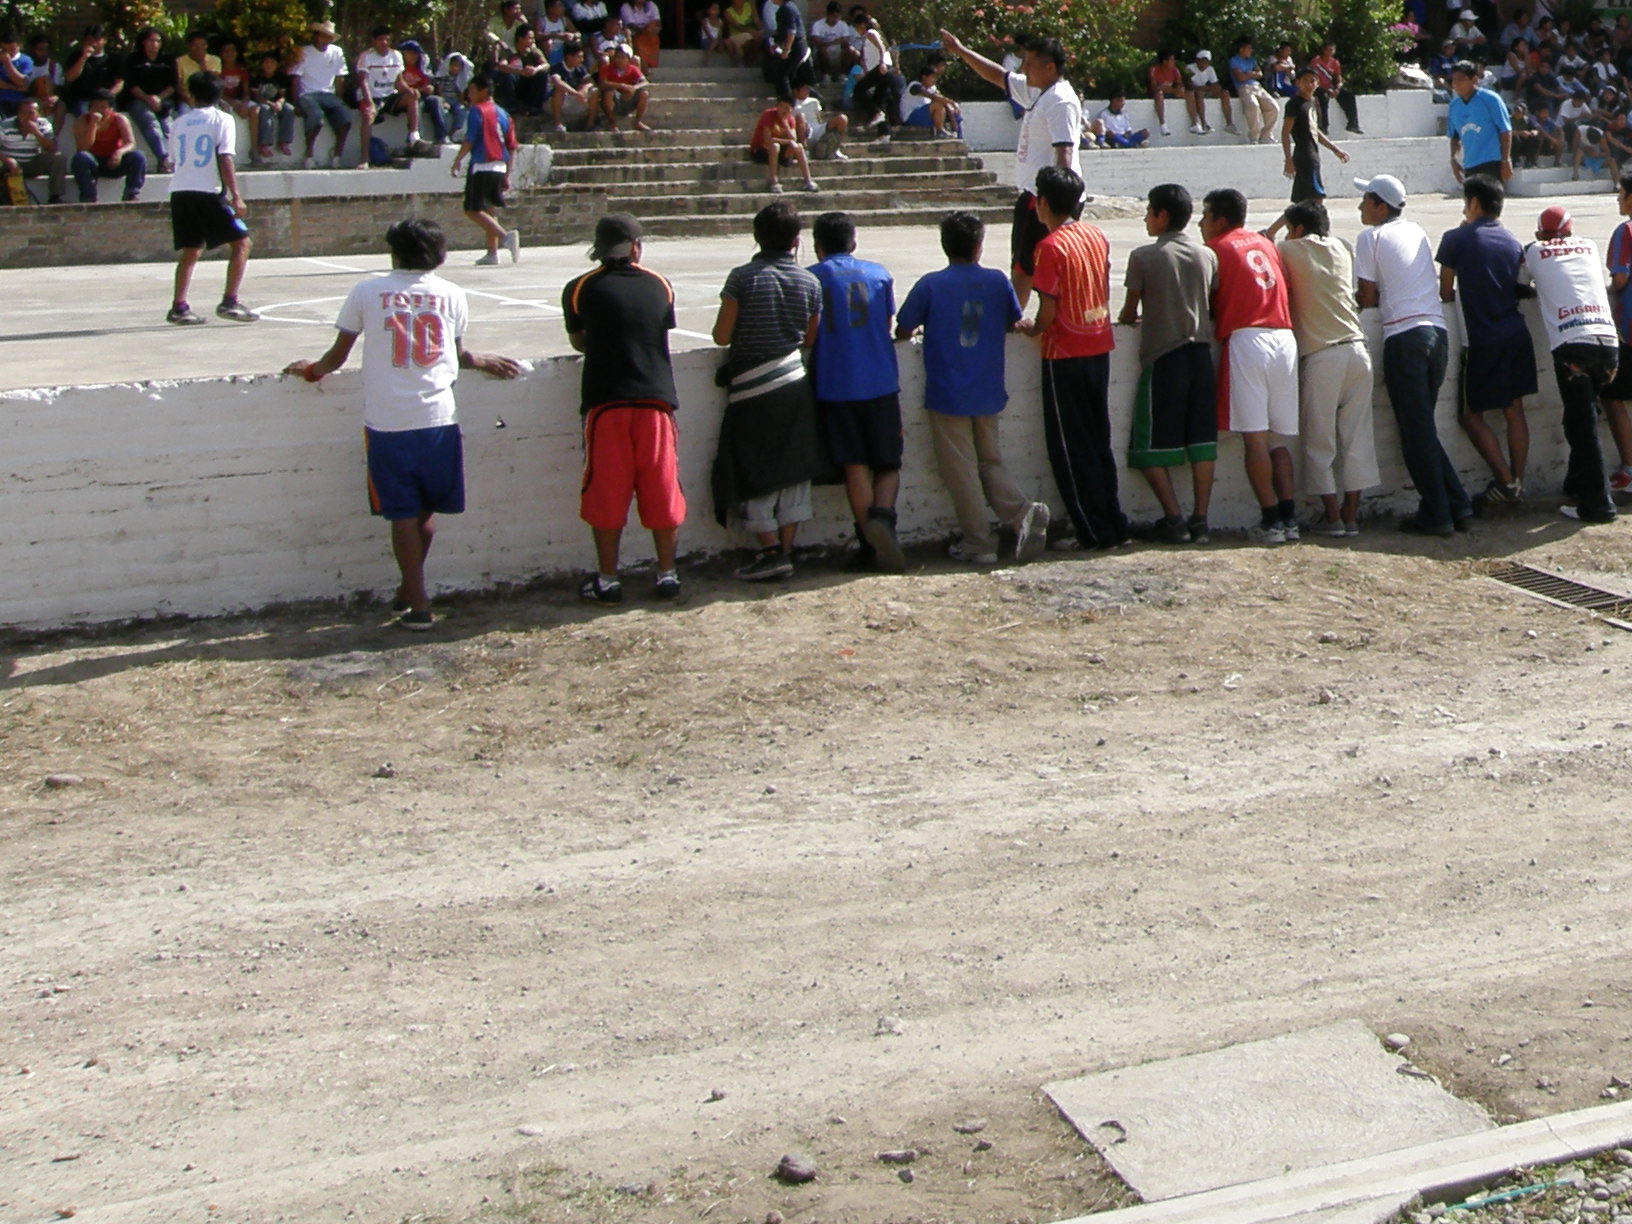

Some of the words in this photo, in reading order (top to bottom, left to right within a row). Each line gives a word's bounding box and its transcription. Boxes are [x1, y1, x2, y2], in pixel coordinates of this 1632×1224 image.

[178, 134, 214, 167] 19
[1246, 249, 1277, 290] 9
[1540, 246, 1592, 259] DEPOT
[384, 311, 445, 368] 10
